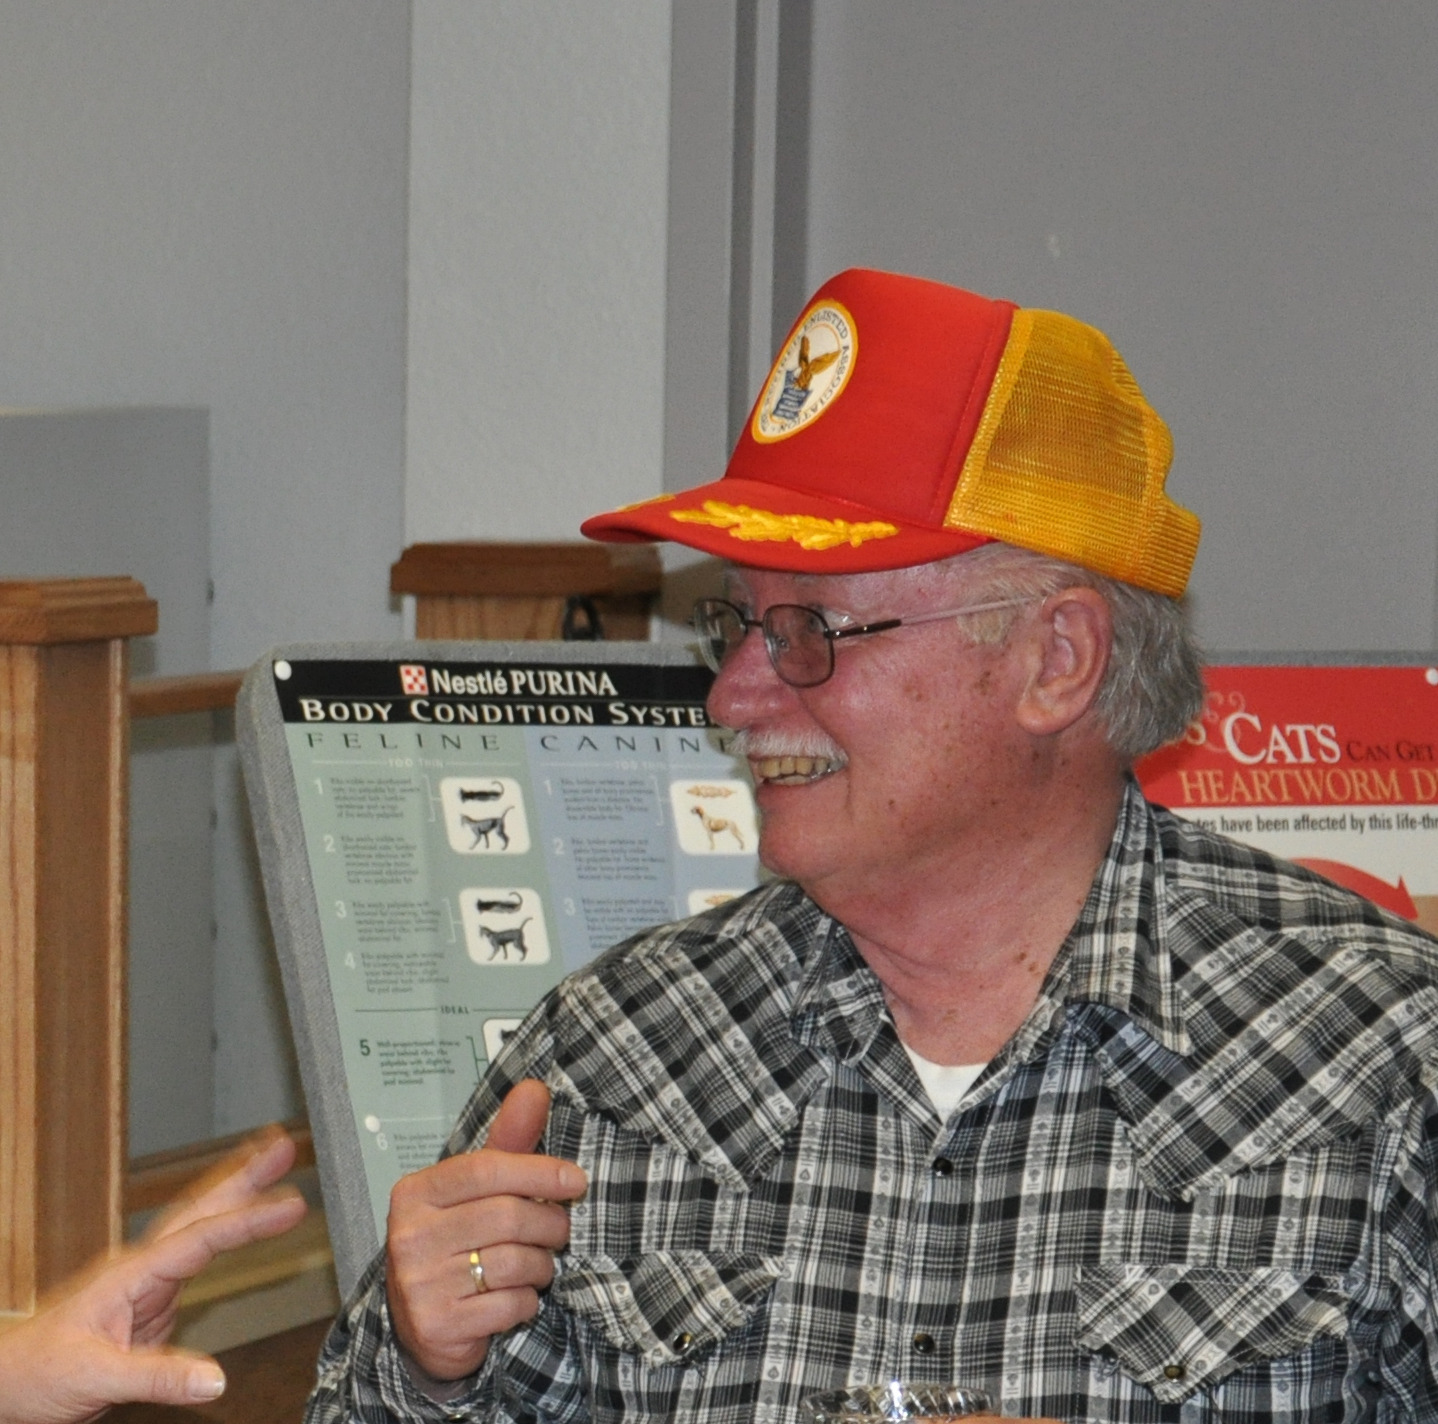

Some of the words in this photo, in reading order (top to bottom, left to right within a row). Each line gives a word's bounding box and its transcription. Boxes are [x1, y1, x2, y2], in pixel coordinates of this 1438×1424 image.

[804, 309, 849, 340] ENLISTED
[778, 344, 852, 434] ASSOCIATION
[431, 667, 508, 696] Nestlé
[510, 669, 619, 697] PURINA
[609, 701, 708, 728] SYSTE
[306, 731, 501, 752] FELINE
[314, 778, 324, 795] 1
[1178, 767, 1404, 804] HEARTWORM
[1195, 816, 1216, 834] tes
[1220, 815, 1253, 833] have
[1256, 814, 1290, 832] been
[1293, 813, 1347, 832] affected
[1349, 814, 1366, 835] by
[1369, 812, 1393, 831] this
[323, 834, 336, 853] 2
[334, 900, 347, 919] 3
[359, 1039, 371, 1057] 5
[376, 1132, 388, 1150] 6
